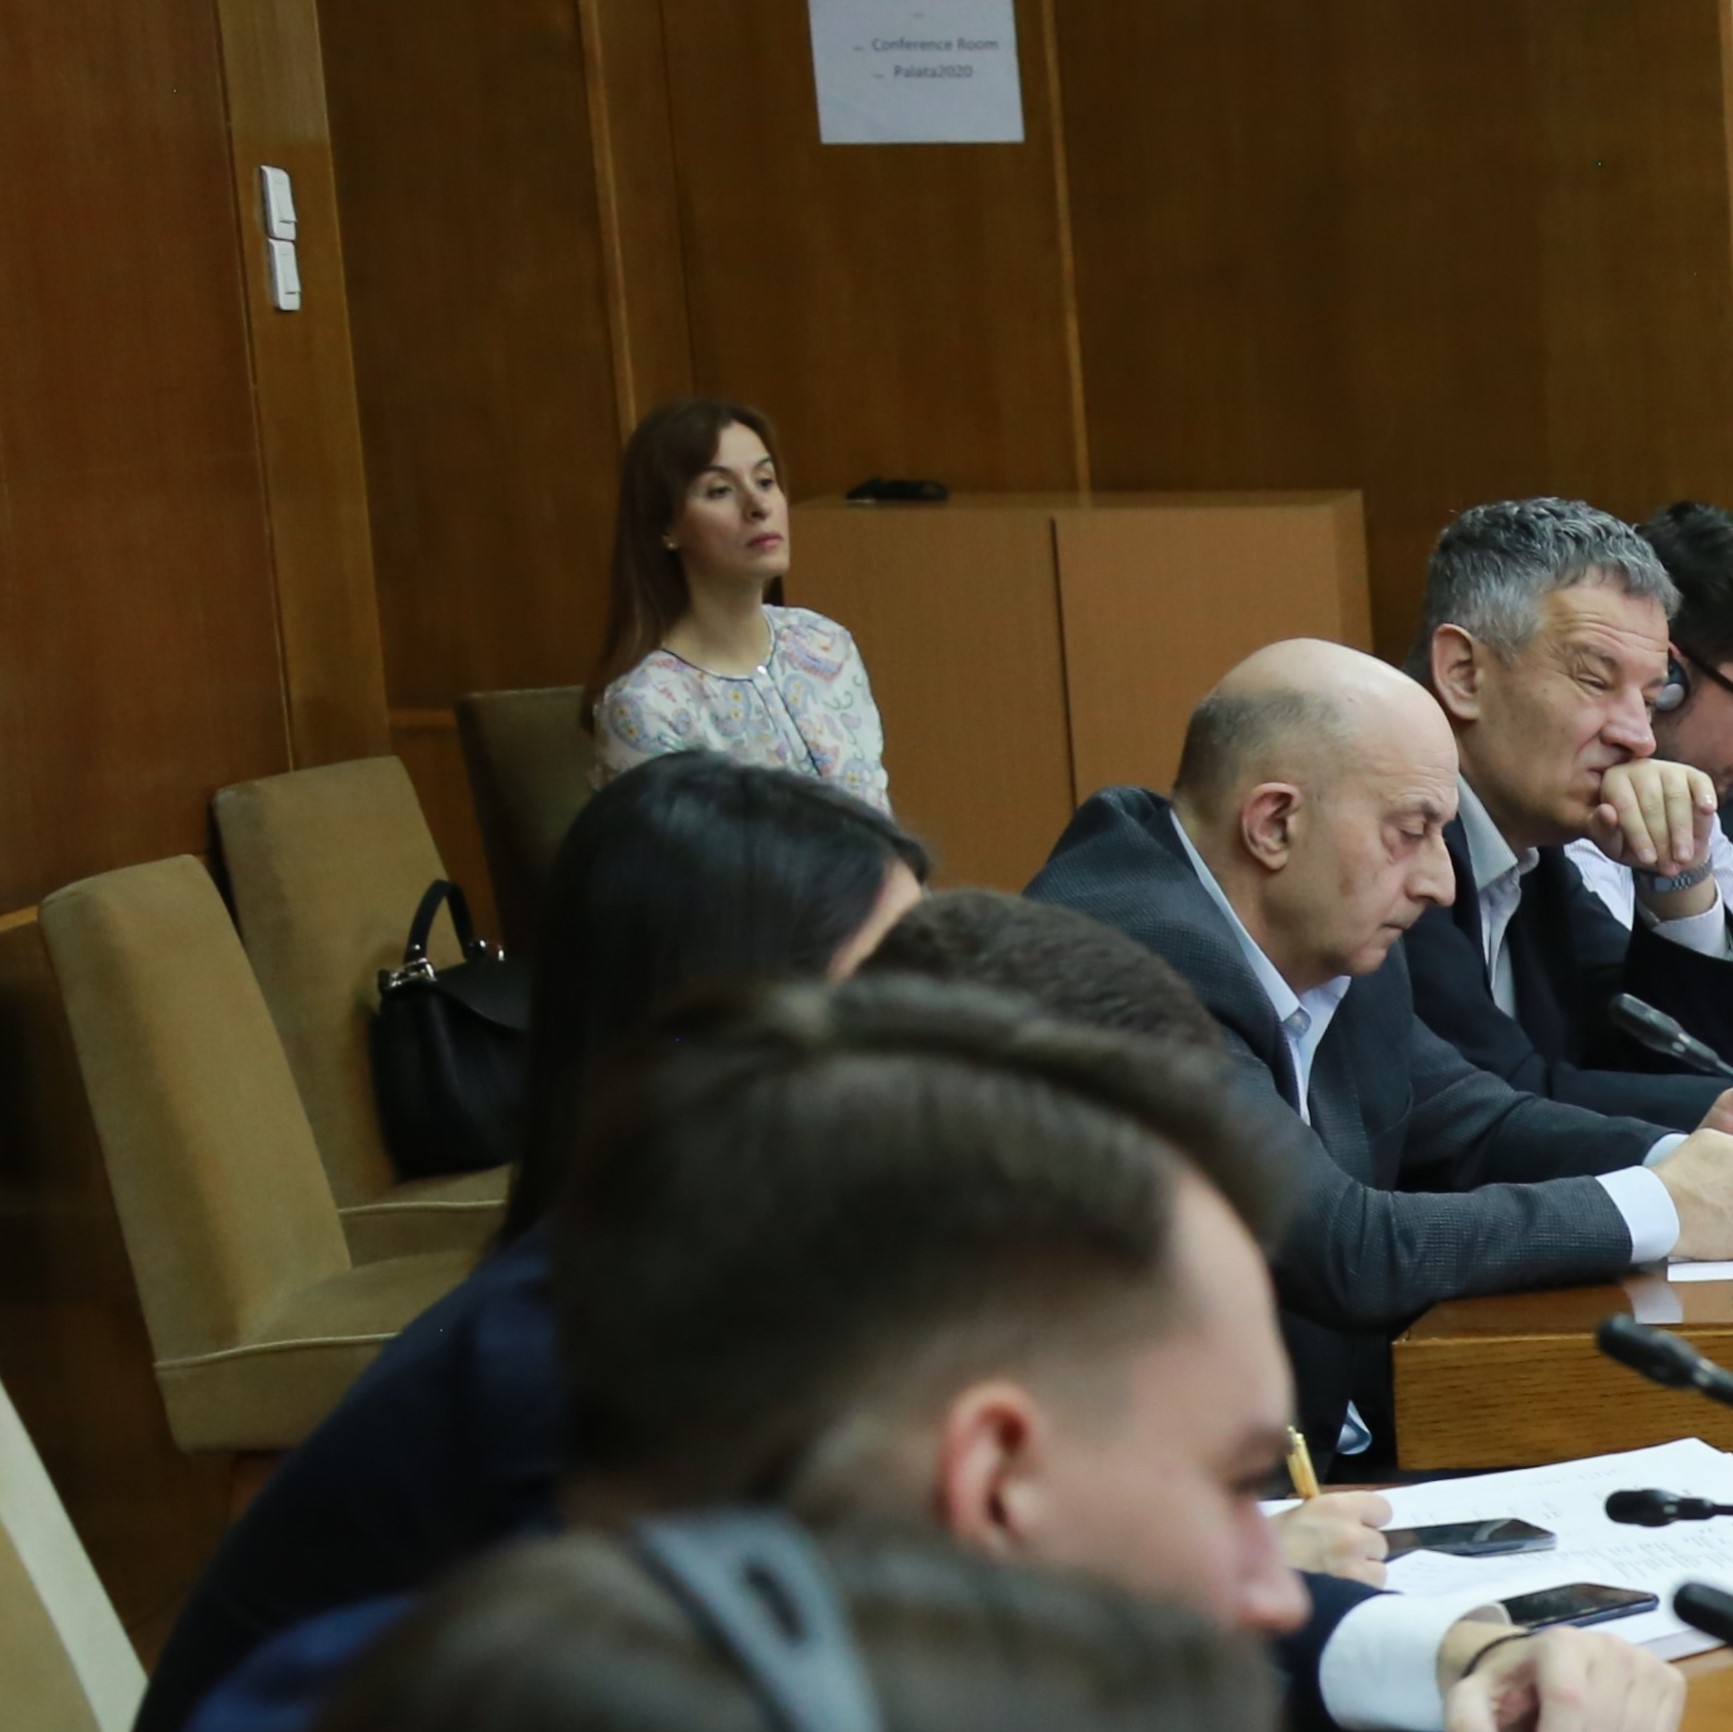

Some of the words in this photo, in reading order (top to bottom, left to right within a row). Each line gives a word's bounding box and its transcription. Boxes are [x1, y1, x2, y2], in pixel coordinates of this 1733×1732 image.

[872, 37, 952, 51] Conference
[957, 38, 999, 51] Room
[893, 65, 973, 78] Palata2020
